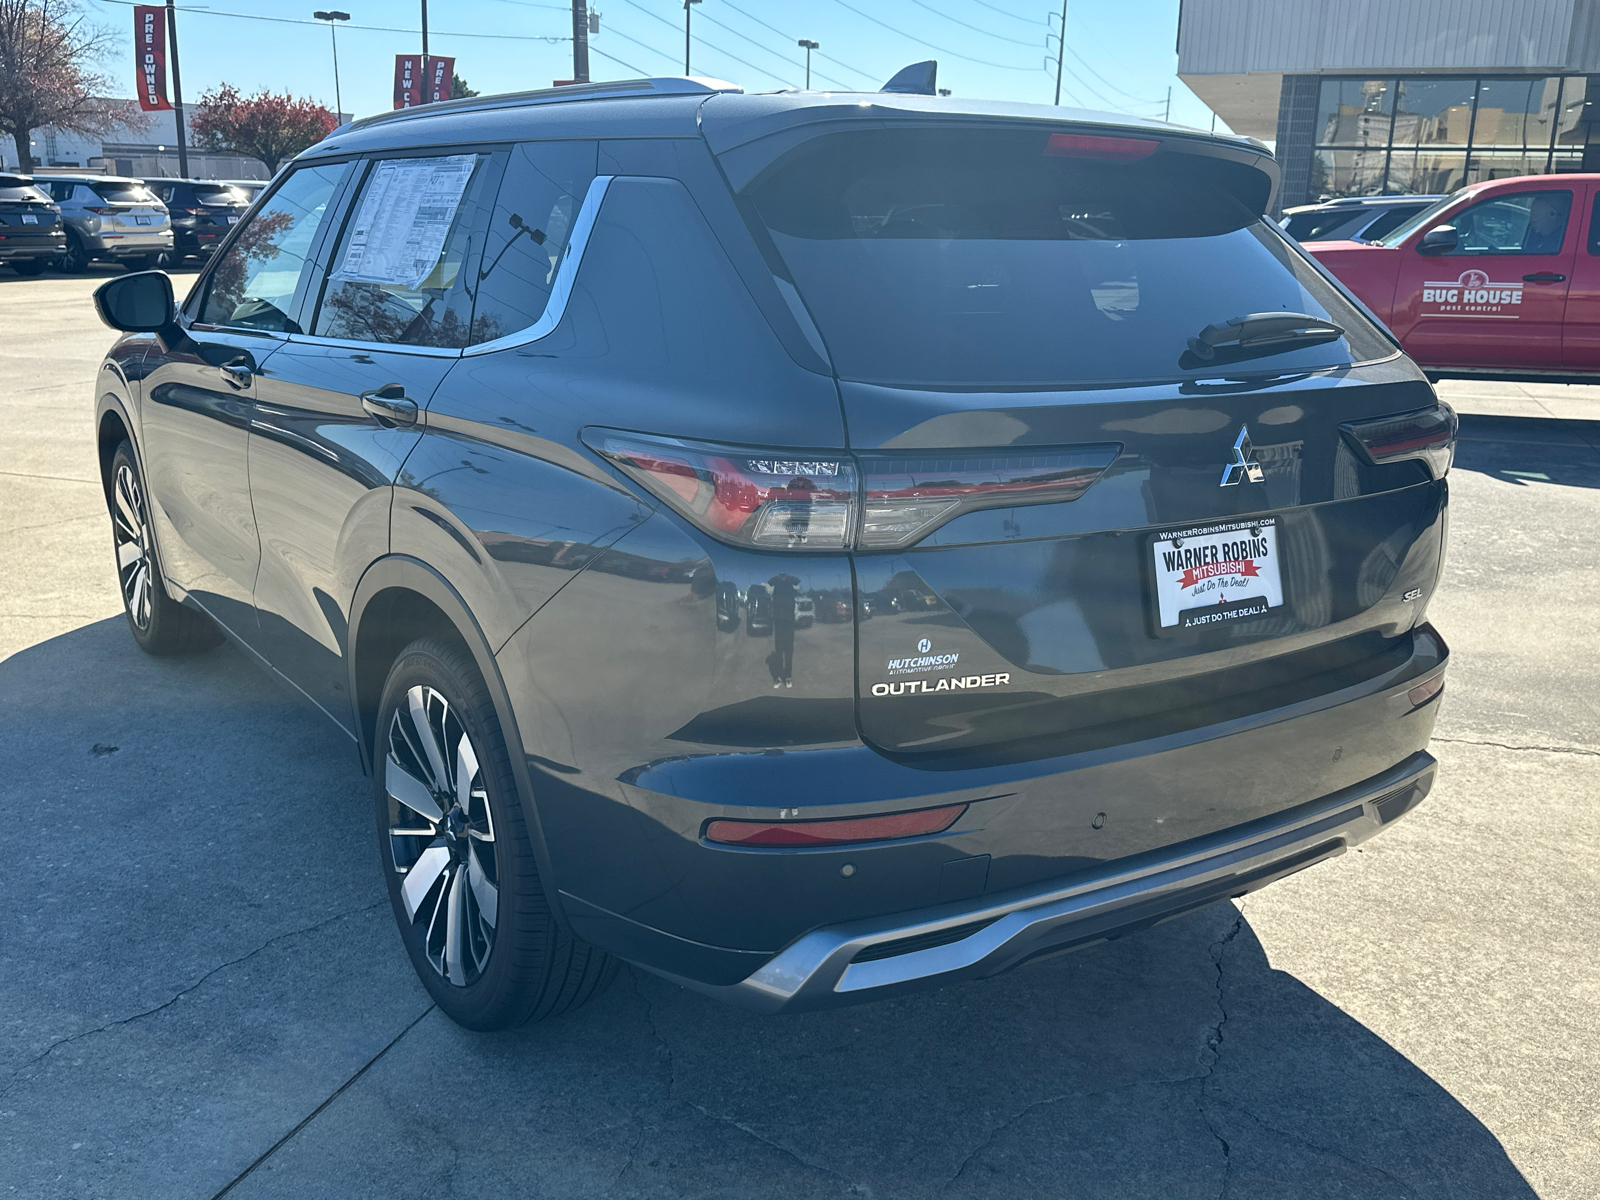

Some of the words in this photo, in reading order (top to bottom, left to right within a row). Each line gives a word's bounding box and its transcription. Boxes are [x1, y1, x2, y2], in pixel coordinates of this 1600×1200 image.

[143, 13, 159, 105] PRE-OWNED
[402, 60, 412, 89] NEW
[433, 61, 445, 103] PRE-O
[1422, 289, 1459, 303] BUG
[1463, 289, 1523, 305] HOUSE
[1440, 304, 1462, 312] pest
[1465, 304, 1502, 312] control
[1163, 544, 1218, 572] WARNER
[1222, 537, 1268, 562] ROBINS
[1192, 561, 1245, 580] MITSUBISHI
[1191, 582, 1206, 597] Just
[1206, 579, 1216, 591] Do
[1217, 577, 1229, 588] The
[1230, 576, 1250, 588] Deal!
[1402, 587, 1423, 603] SEL
[1192, 615, 1210, 626] JUST
[1211, 613, 1222, 622] DO
[1222, 610, 1238, 620] THE
[1238, 606, 1260, 617] DEAL!
[887, 653, 959, 670] HUTCHINSON
[871, 672, 1011, 697] OUTLANDER
